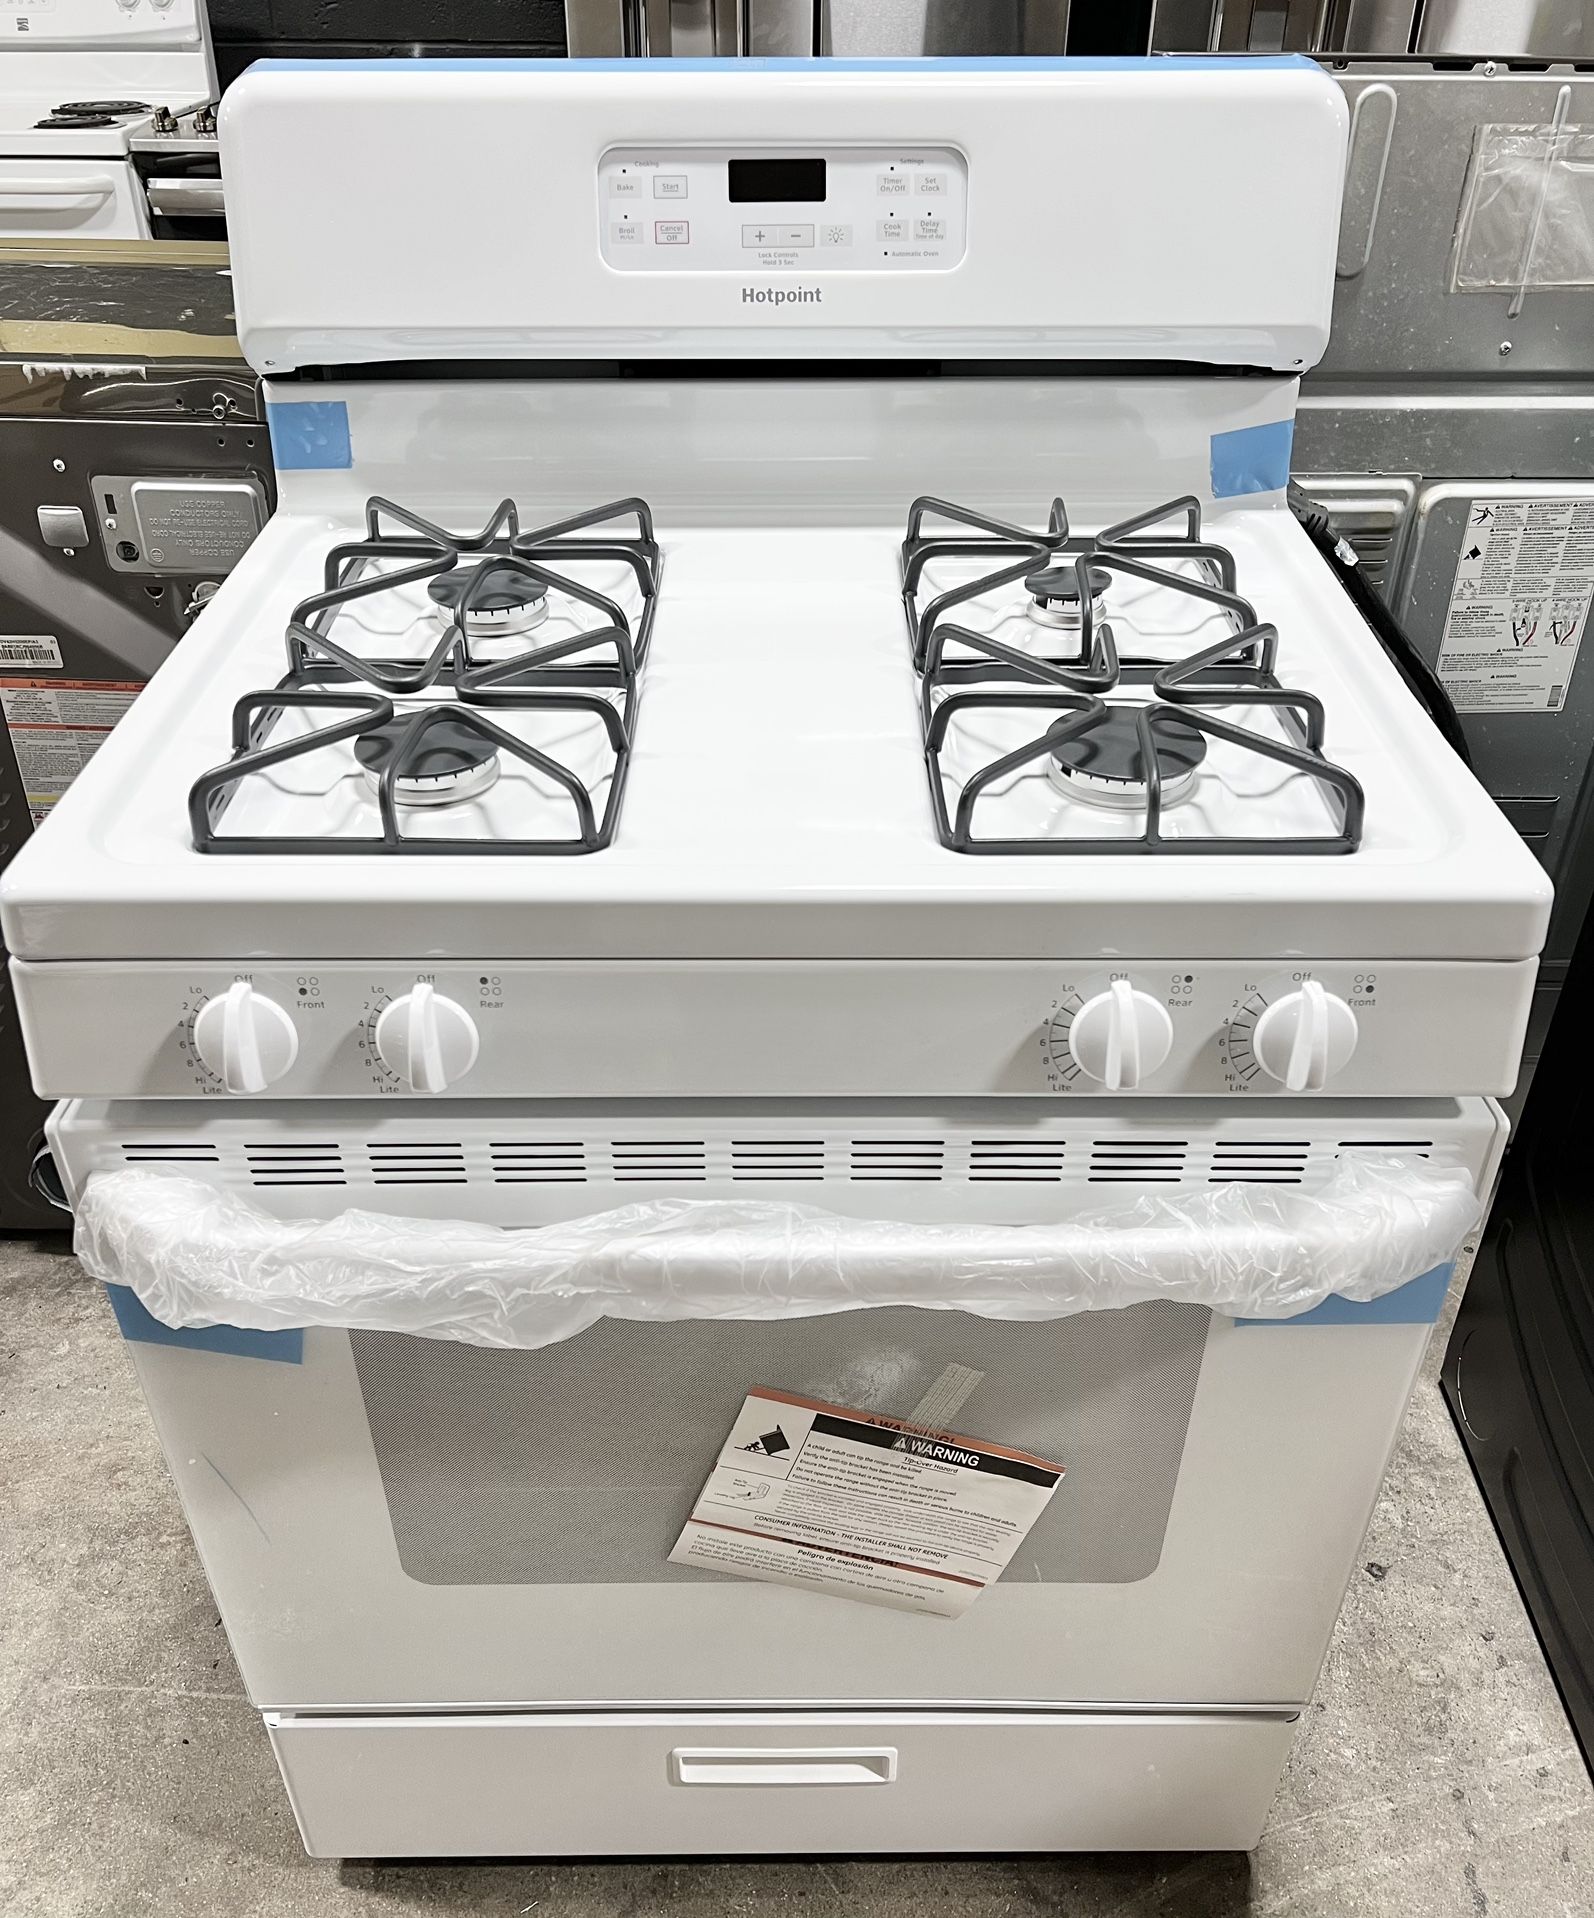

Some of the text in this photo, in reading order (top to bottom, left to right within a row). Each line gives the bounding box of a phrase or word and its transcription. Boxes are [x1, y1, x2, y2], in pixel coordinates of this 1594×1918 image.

[900, 158, 924, 166] Settings
[880, 184, 906, 192] On/Off
[920, 220, 940, 229] Delay
[742, 286, 822, 306] Hotpoint
[416, 974, 436, 984] Off
[1109, 972, 1128, 982] Off
[1292, 972, 1312, 982] Off
[190, 986, 202, 994] Lo
[372, 986, 384, 994] Lo
[1062, 984, 1075, 992] Lo
[1244, 984, 1256, 992] Lo
[182, 1002, 188, 1010] 2
[297, 1001, 325, 1009] Front
[364, 1002, 370, 1010] 2
[480, 1000, 504, 1008] Rear
[1052, 1000, 1058, 1008] 2
[1168, 999, 1192, 1007] Rear
[1348, 998, 1376, 1006] Front
[358, 1020, 364, 1028] 4
[1043, 1018, 1050, 1026] 4
[180, 1041, 186, 1049] 6
[358, 1040, 366, 1048] 6
[1040, 1038, 1046, 1046] 6
[1218, 1038, 1226, 1046] 6
[365, 1059, 372, 1067] 8
[1042, 1056, 1049, 1064] 8
[1221, 1056, 1228, 1064] 8
[1048, 1074, 1058, 1082] Hi
[1224, 1074, 1236, 1082] Hi
[203, 1086, 222, 1094] Lite
[380, 1086, 400, 1094] Lite
[1052, 1084, 1072, 1092] Lite
[1230, 1084, 1248, 1092] Lite
[911, 1440, 980, 1467] WARNING
[934, 1464, 958, 1474] Hazard
[754, 1514, 791, 1527] CONSUMER
[791, 1522, 836, 1536] INFORMATION
[854, 1536, 888, 1547] INSTALLER
[888, 1542, 908, 1550] SHALL
[922, 1550, 949, 1560] REMOVE
[798, 1549, 824, 1560] Peligro
[837, 1559, 874, 1570] explosión
